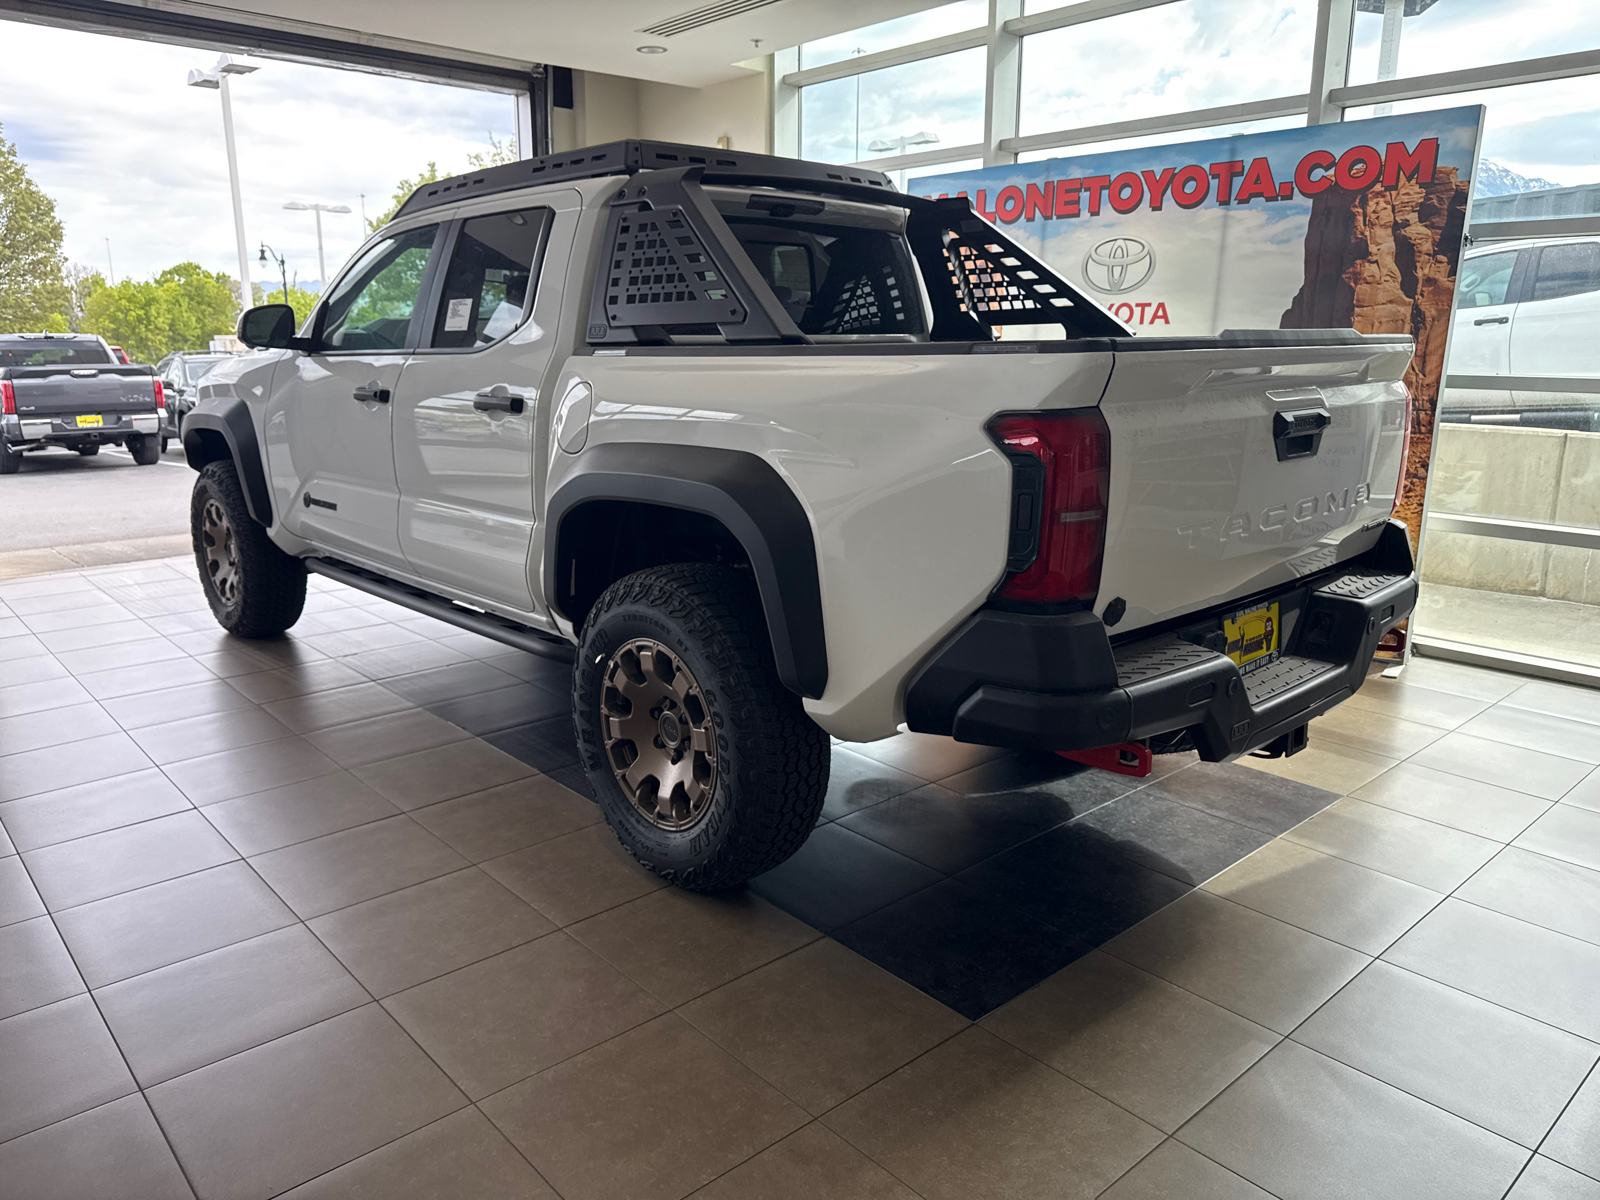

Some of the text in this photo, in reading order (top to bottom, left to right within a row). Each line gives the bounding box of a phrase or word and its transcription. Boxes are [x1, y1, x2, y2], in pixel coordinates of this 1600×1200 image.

[923, 137, 1440, 225] LONETOYOTA.COM
[1107, 302, 1171, 325] OTA
[1177, 482, 1370, 549] TACOMA
[622, 613, 672, 635] TERRITORY
[578, 628, 611, 771] WRANGLER
[690, 688, 733, 856] GOODYEAR
